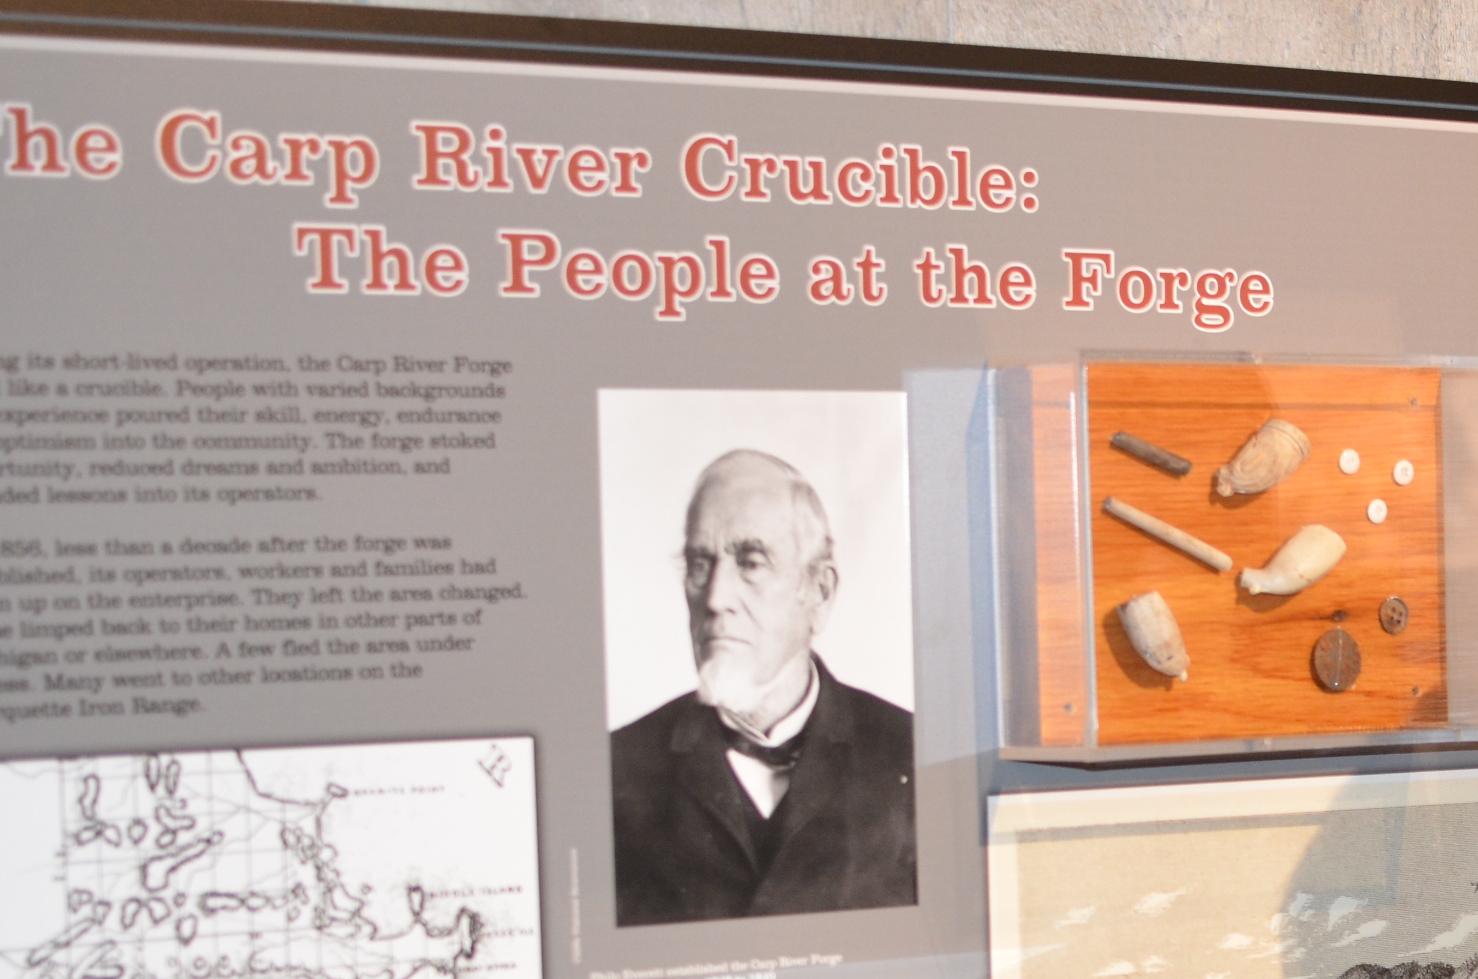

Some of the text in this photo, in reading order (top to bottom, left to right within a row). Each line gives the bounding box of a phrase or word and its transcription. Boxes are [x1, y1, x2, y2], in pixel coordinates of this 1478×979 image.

[0, 101, 1039, 213] he Carp River Crucible:
[292, 223, 1274, 333] The People at the Forge
